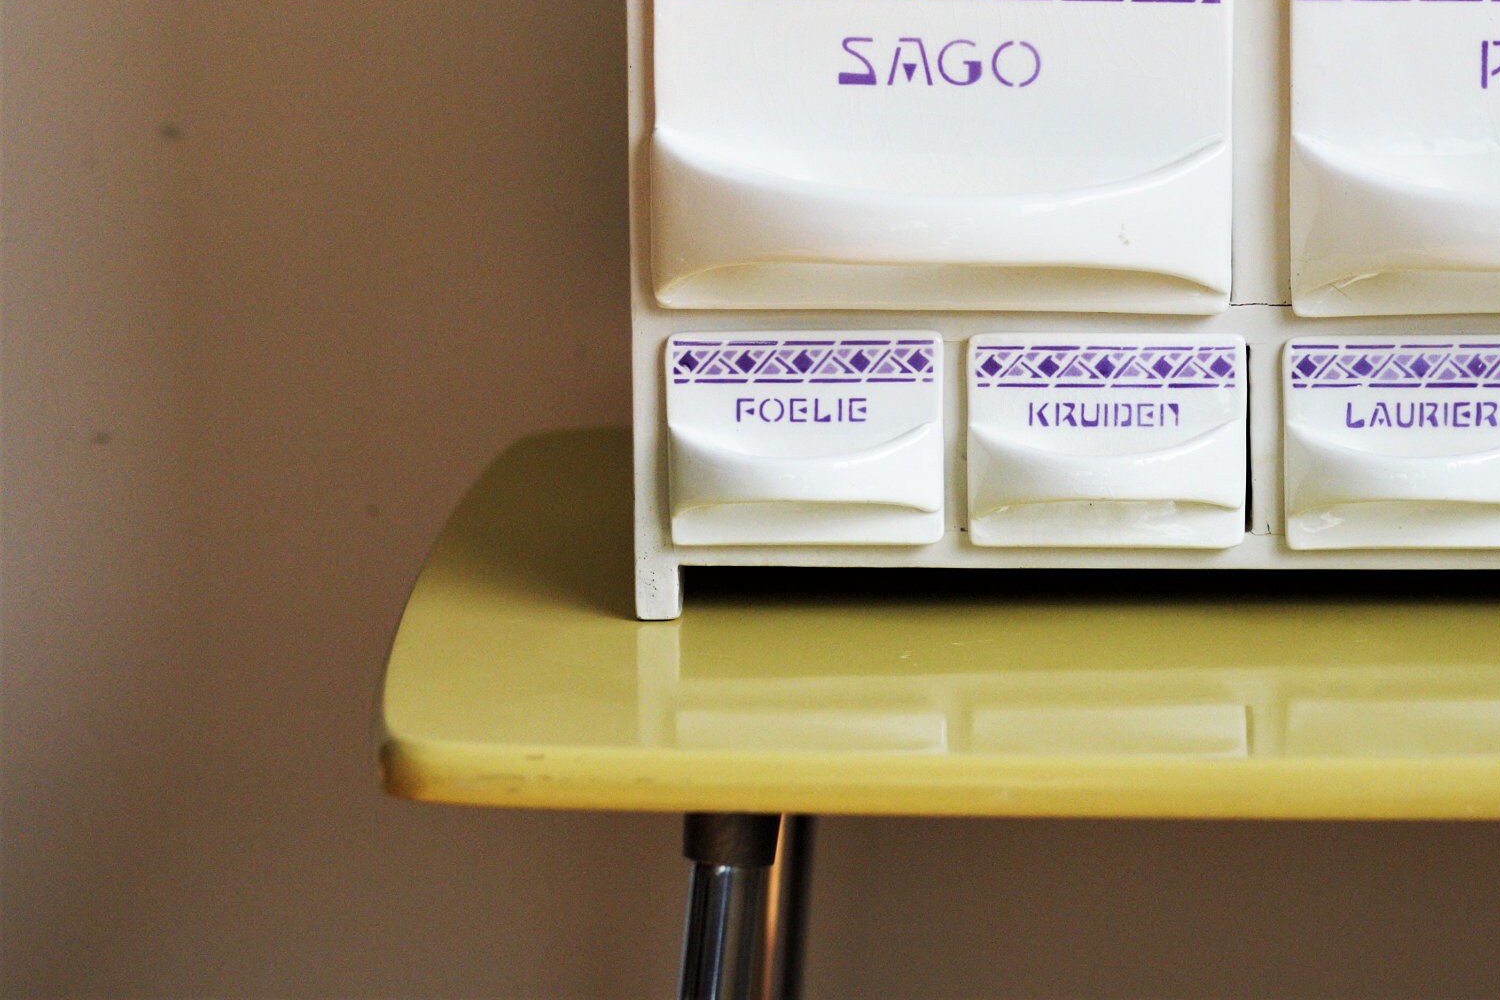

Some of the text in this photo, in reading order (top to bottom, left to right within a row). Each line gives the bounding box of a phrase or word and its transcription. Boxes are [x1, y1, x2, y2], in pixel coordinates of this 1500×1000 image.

[838, 37, 1042, 87] SAGO
[736, 398, 867, 422] FOELIE
[1028, 402, 1179, 427] KRUIDEN
[1346, 401, 1499, 428] LAURIER
